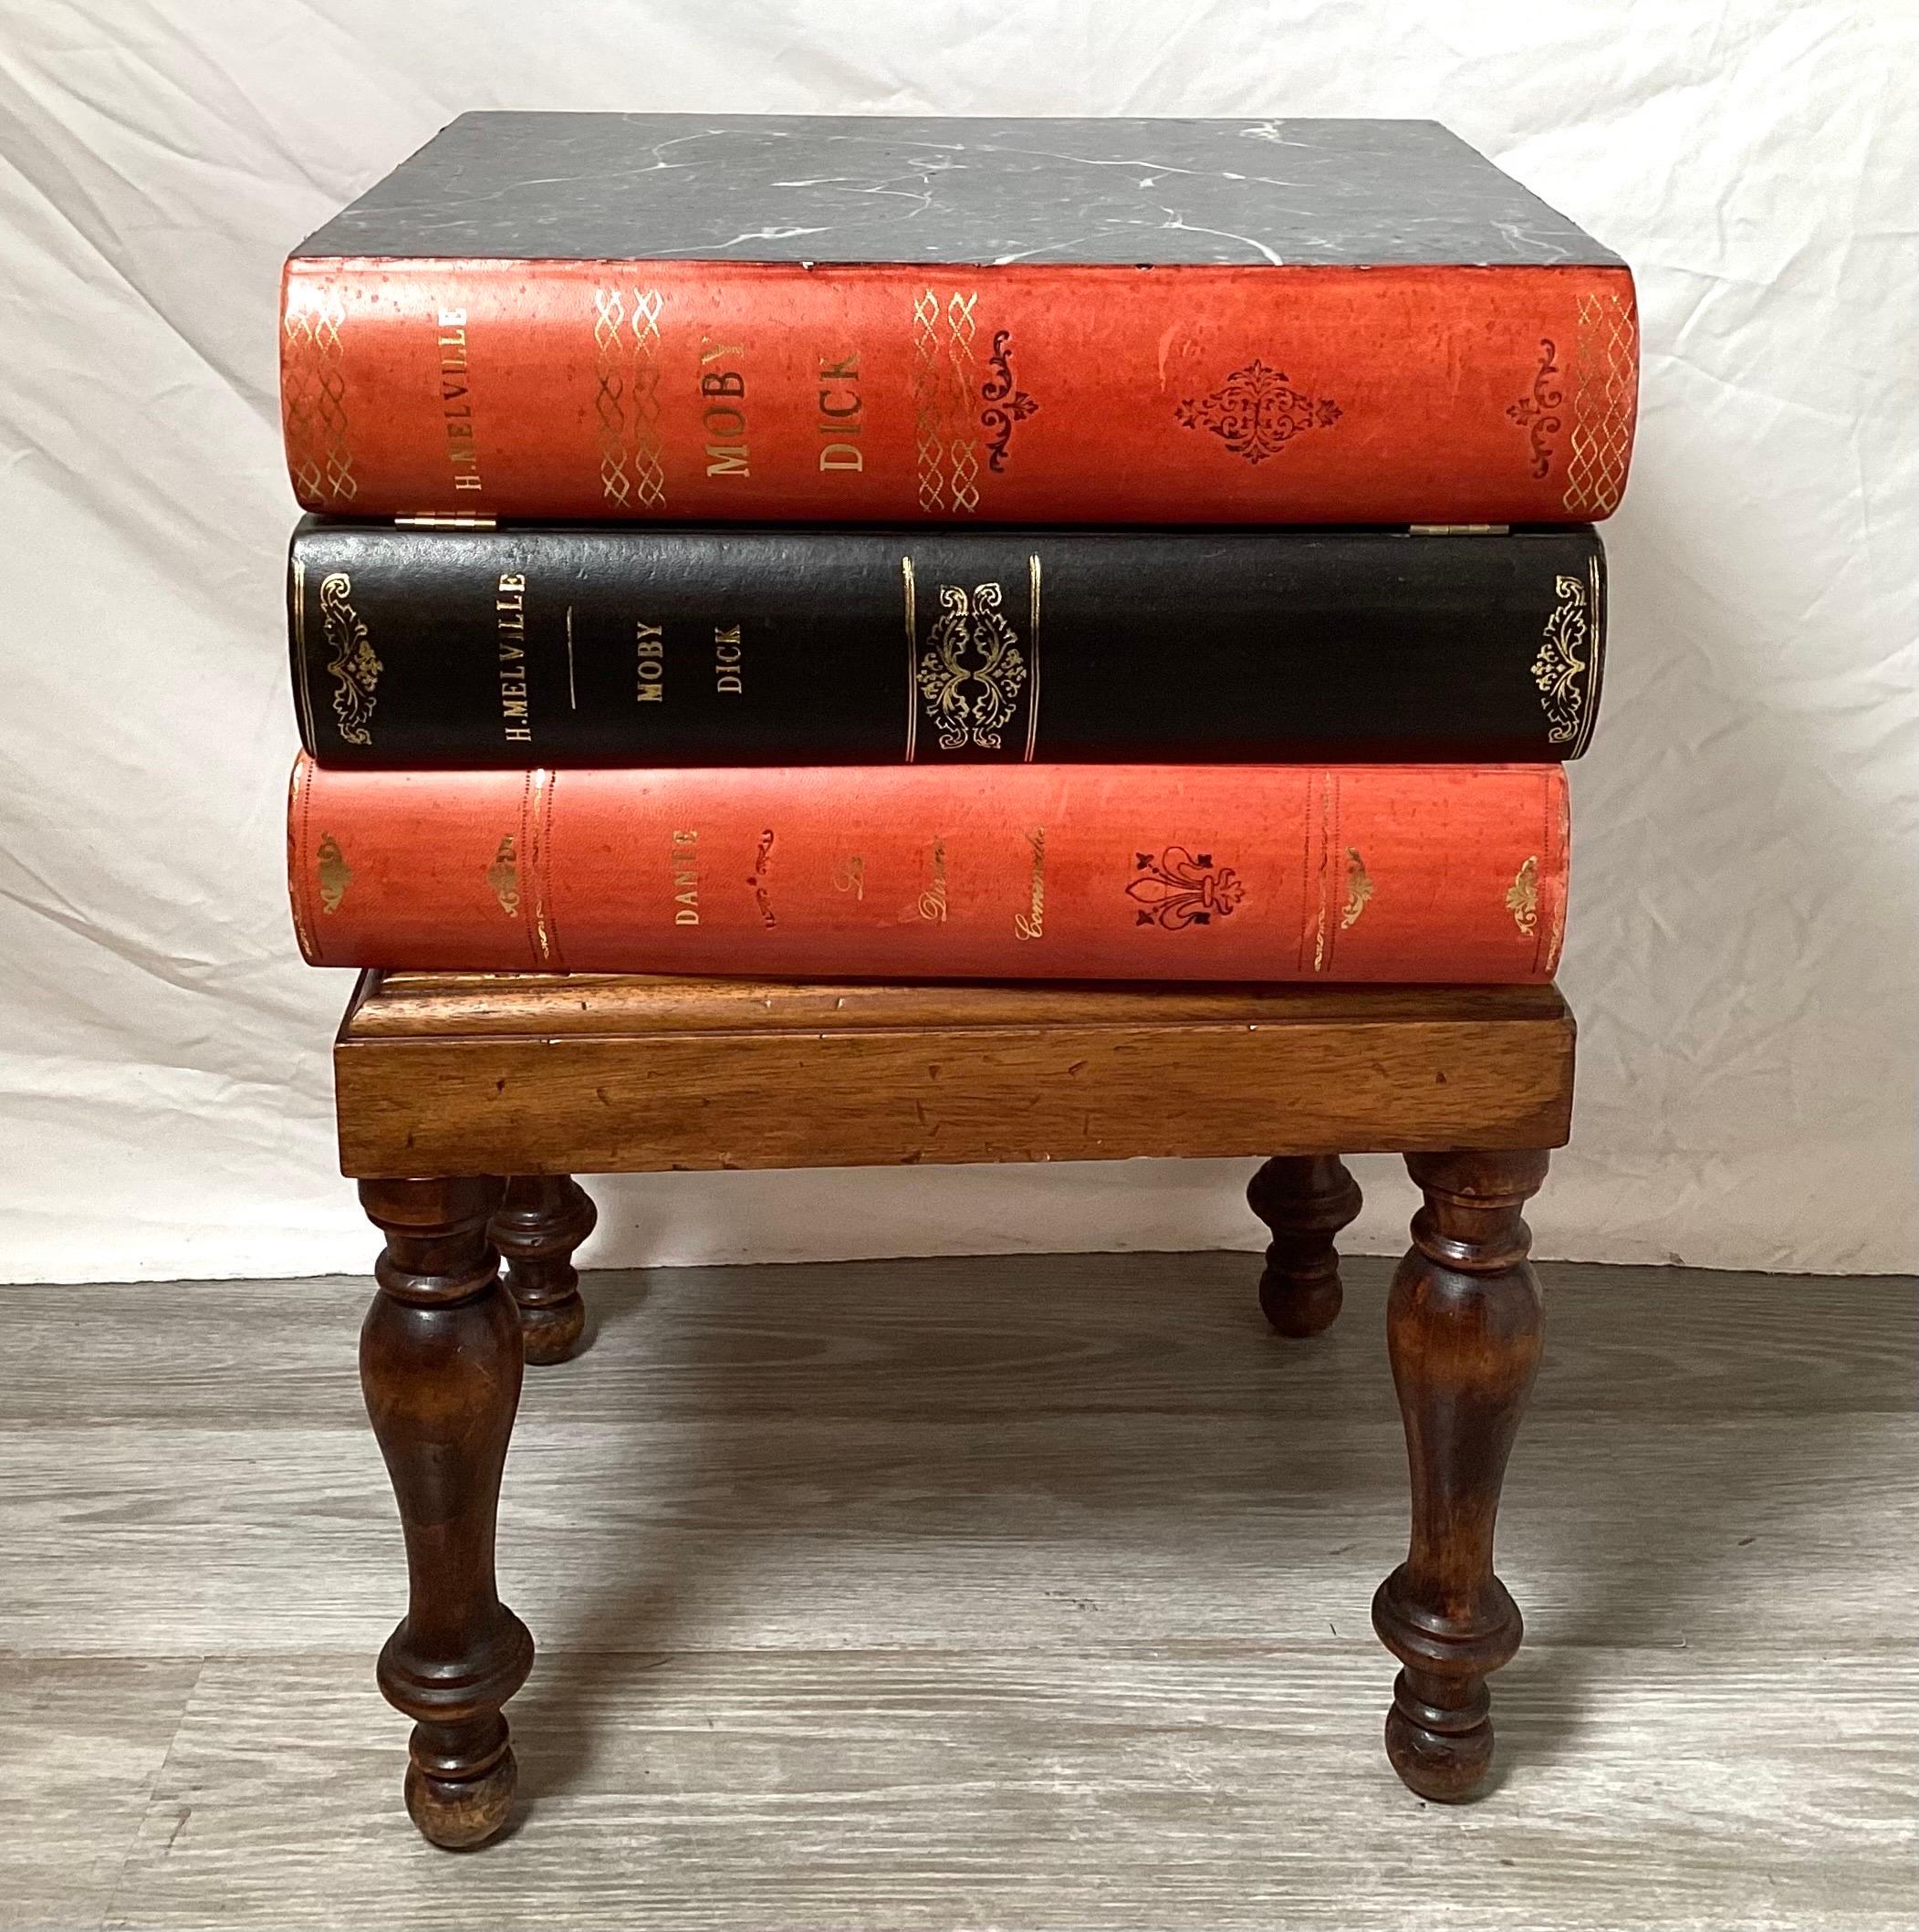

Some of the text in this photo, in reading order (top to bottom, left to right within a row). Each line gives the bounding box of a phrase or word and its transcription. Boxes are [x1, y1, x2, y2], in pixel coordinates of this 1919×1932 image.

[701, 336, 750, 478] MOBY
[818, 350, 864, 473] DICK
[496, 573, 532, 742] H.MELVILLE
[637, 621, 663, 702] MOBY
[714, 624, 742, 694] DICK
[672, 830, 700, 925] DANTE
